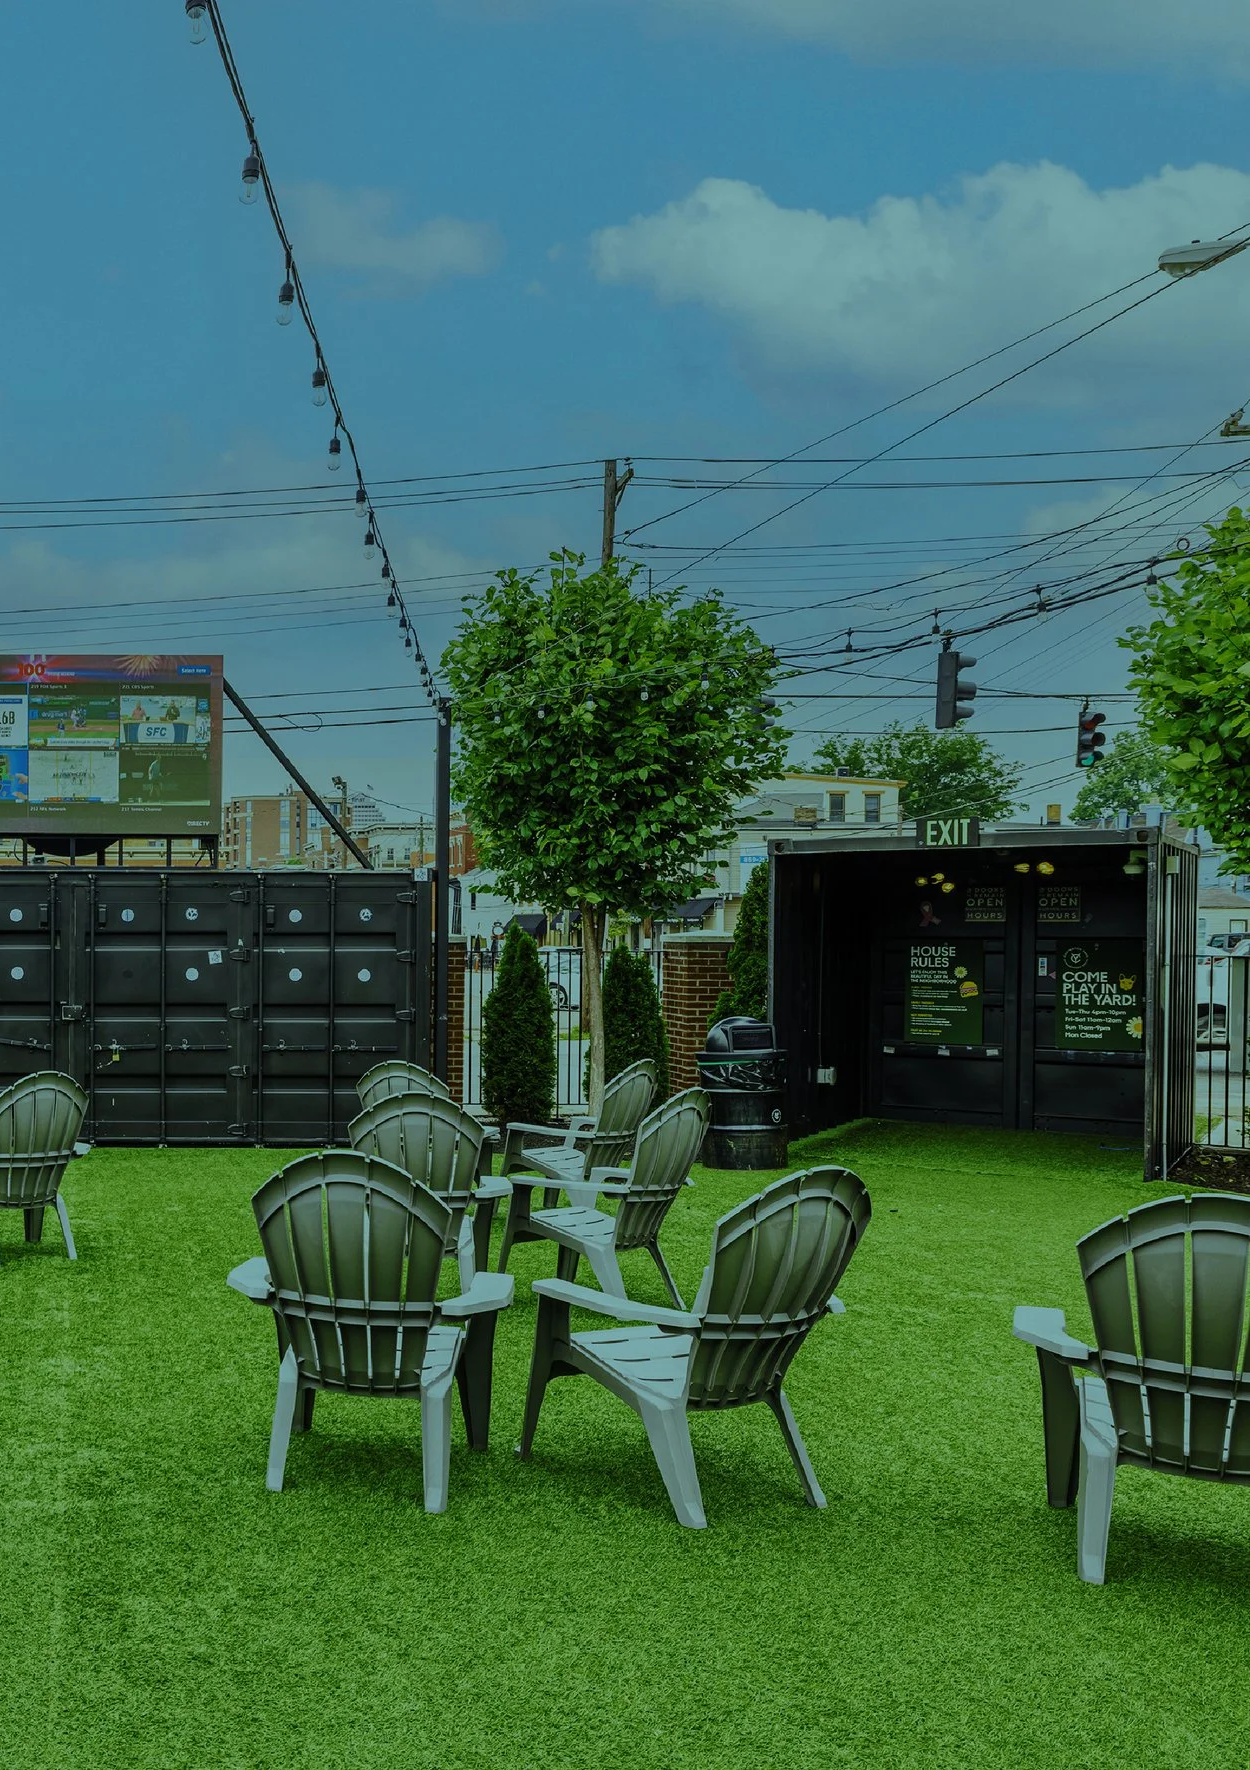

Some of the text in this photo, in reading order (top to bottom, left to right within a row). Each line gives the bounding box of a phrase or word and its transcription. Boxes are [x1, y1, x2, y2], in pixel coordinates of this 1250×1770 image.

[146, 727, 167, 736] SFC
[926, 818, 971, 846] EXIT
[966, 898, 1003, 907] OPEN
[1038, 897, 1078, 907] OPEN
[910, 946, 957, 957] HOUSE
[910, 957, 950, 968] RULES
[1062, 971, 1108, 983] COME
[1062, 983, 1117, 994] PLAY IN
[1062, 994, 1137, 1007] THE YARD!
[1091, 1009, 1127, 1017] 4pm-10pm
